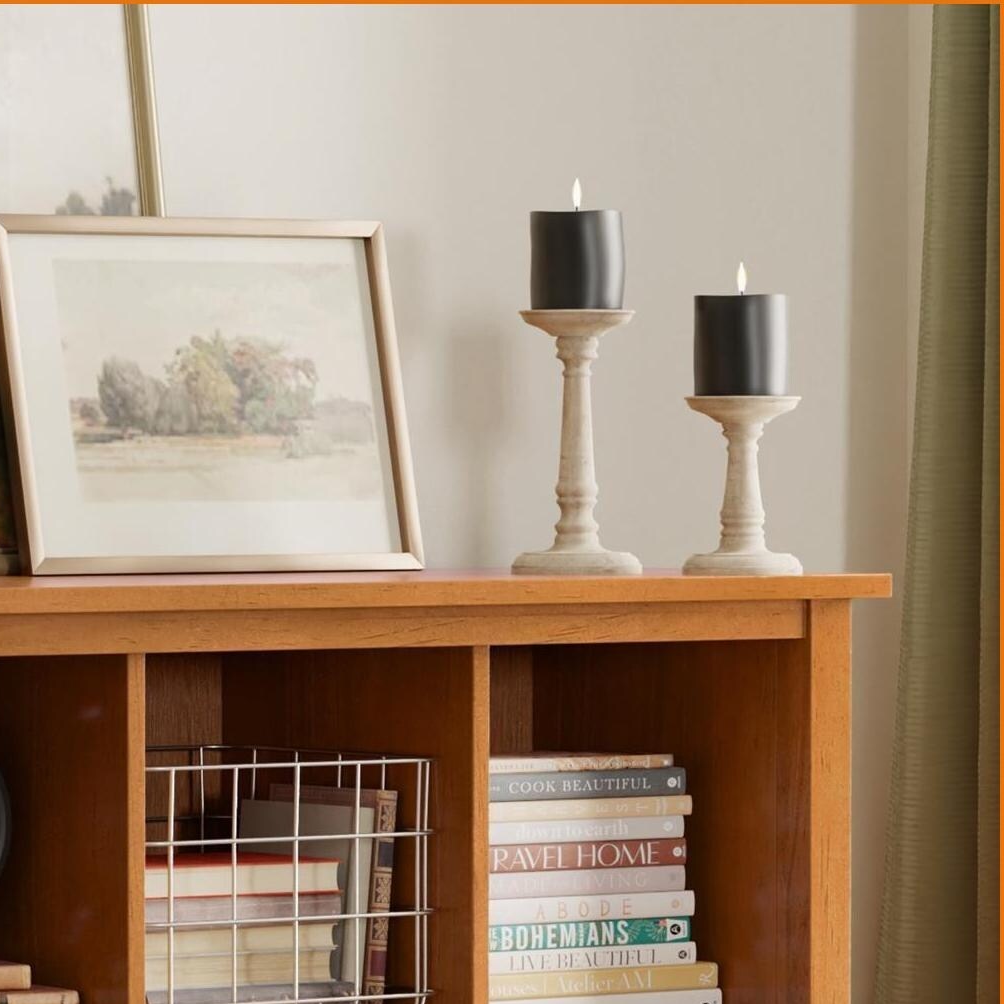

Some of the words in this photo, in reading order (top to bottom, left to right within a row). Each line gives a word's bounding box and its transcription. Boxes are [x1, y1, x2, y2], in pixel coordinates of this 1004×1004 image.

[508, 780, 556, 794] COOK
[562, 777, 652, 792] BEAUTIFUL
[583, 819, 629, 837] earth
[493, 845, 570, 871] RAVEL
[578, 842, 660, 867] HOME
[537, 898, 632, 920] ABODE
[501, 921, 630, 950] BOHEMIANS
[509, 954, 552, 971] LIVE
[557, 949, 661, 969] BEAUTIFUL
[491, 984, 539, 998] ouses
[559, 974, 615, 993] Atelier
